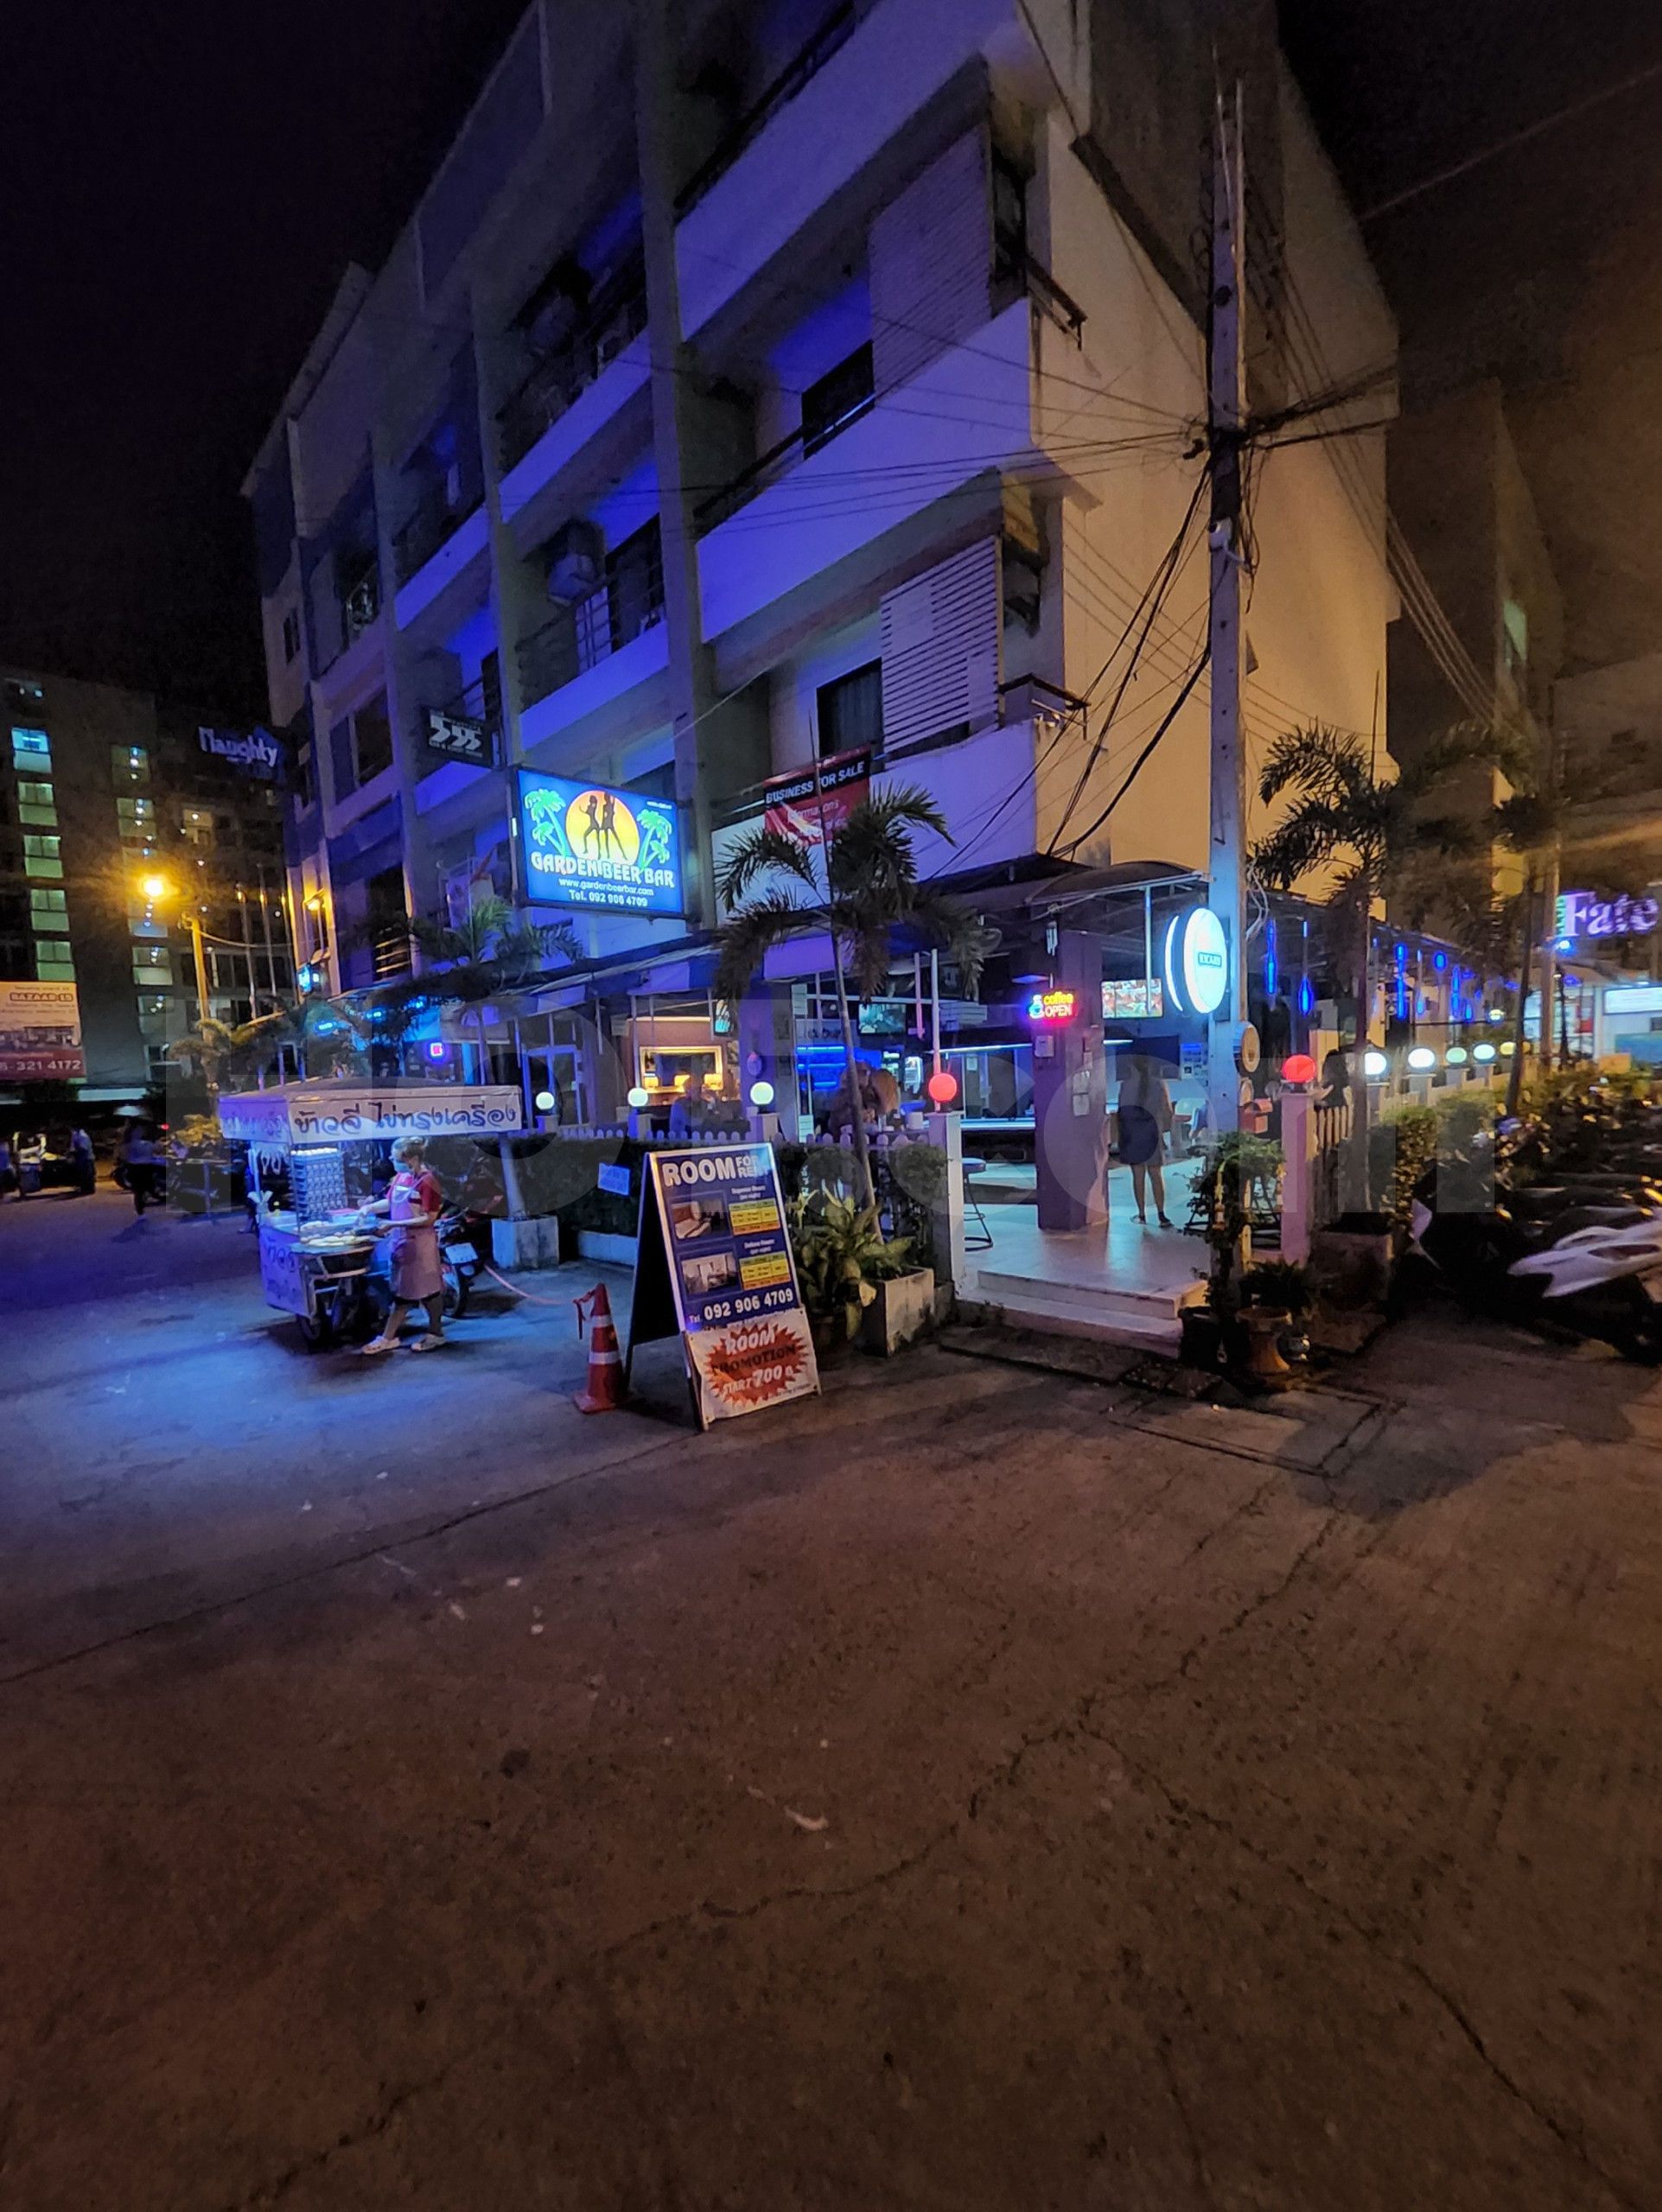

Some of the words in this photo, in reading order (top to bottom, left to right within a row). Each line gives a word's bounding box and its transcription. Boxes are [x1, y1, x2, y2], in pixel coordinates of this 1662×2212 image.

[766, 781, 814, 804] BUSINESS
[818, 773, 837, 789] OR
[838, 761, 865, 781] SALE
[531, 850, 602, 878] GARDEN
[602, 860, 642, 885] BEER
[644, 867, 675, 888] BAR
[558, 878, 654, 897] www.gardenbeerbar.com
[589, 892, 607, 904] 092
[1043, 991, 1073, 1005] coffee
[1044, 1004, 1072, 1017] OPEN
[16, 1061, 42, 1071] 321
[48, 1059, 81, 1071] 4172
[662, 1156, 735, 1187] ROOM
[704, 1301, 731, 1321] 092
[735, 1294, 761, 1313] 906
[764, 1287, 793, 1307] 4709
[725, 1327, 775, 1355] ROOM
[723, 1378, 754, 1396] START
[753, 1364, 783, 1388] 700
